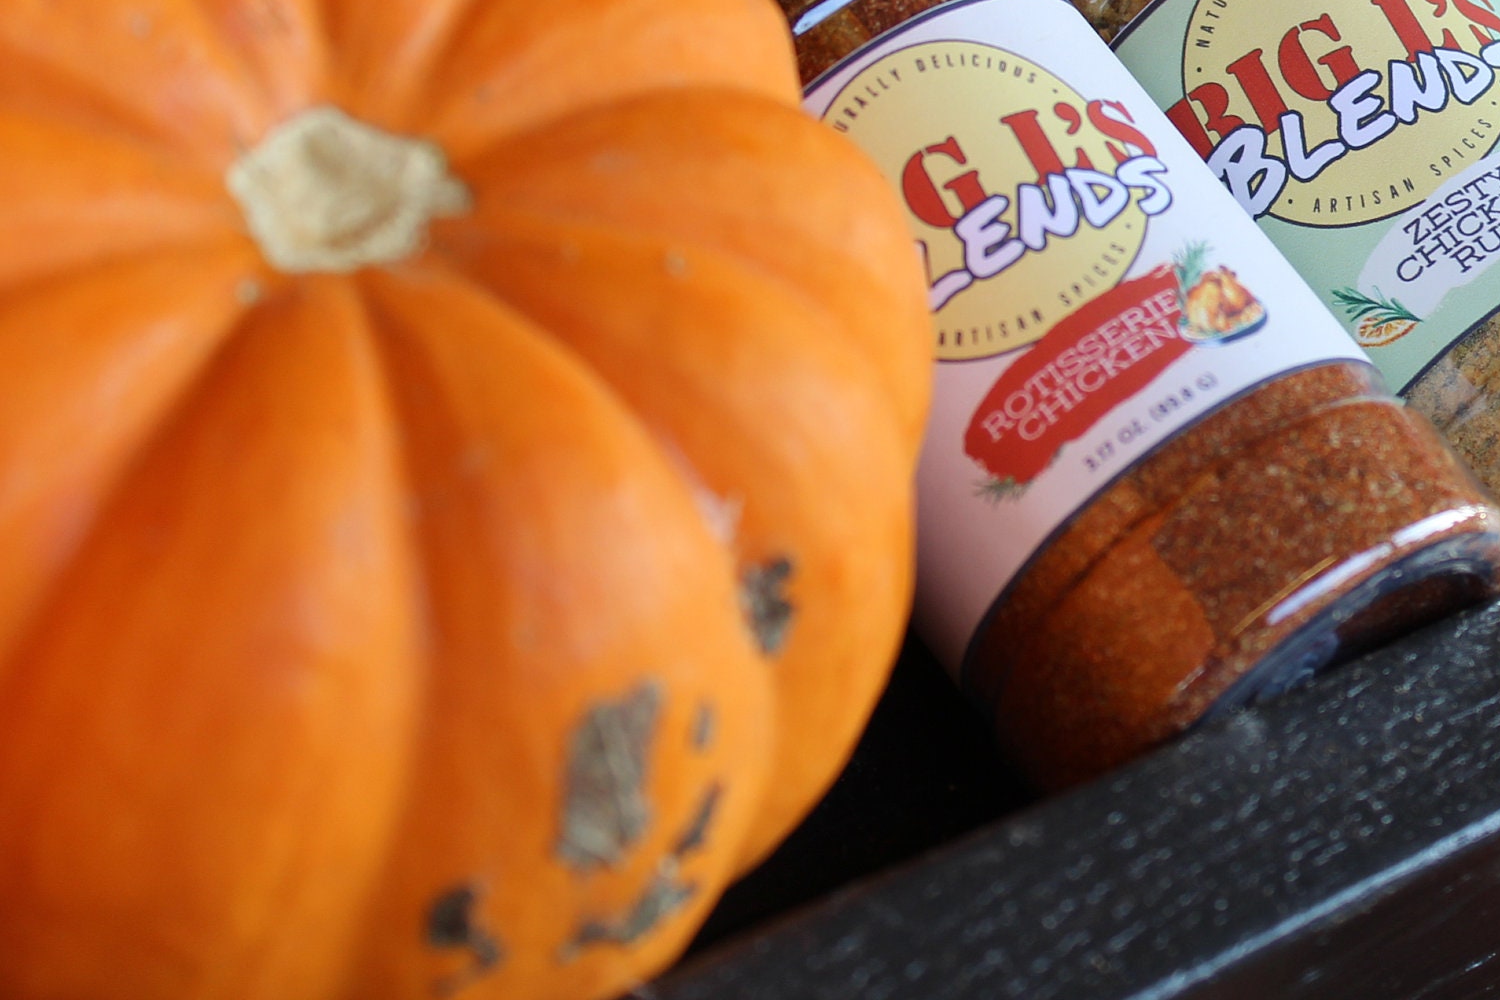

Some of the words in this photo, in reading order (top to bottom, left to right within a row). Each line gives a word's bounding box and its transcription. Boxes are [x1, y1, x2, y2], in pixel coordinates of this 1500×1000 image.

[833, 68, 902, 133] URALLY
[915, 54, 1038, 84] DELICIOUS
[1165, 13, 1361, 163] BIG
[914, 153, 1173, 314] LENDS
[1313, 177, 1415, 213] ARTISAN
[1430, 118, 1493, 177] SPICES
[981, 288, 1181, 443] ROTISSERIE
[1017, 317, 1179, 442] CHICKEN
